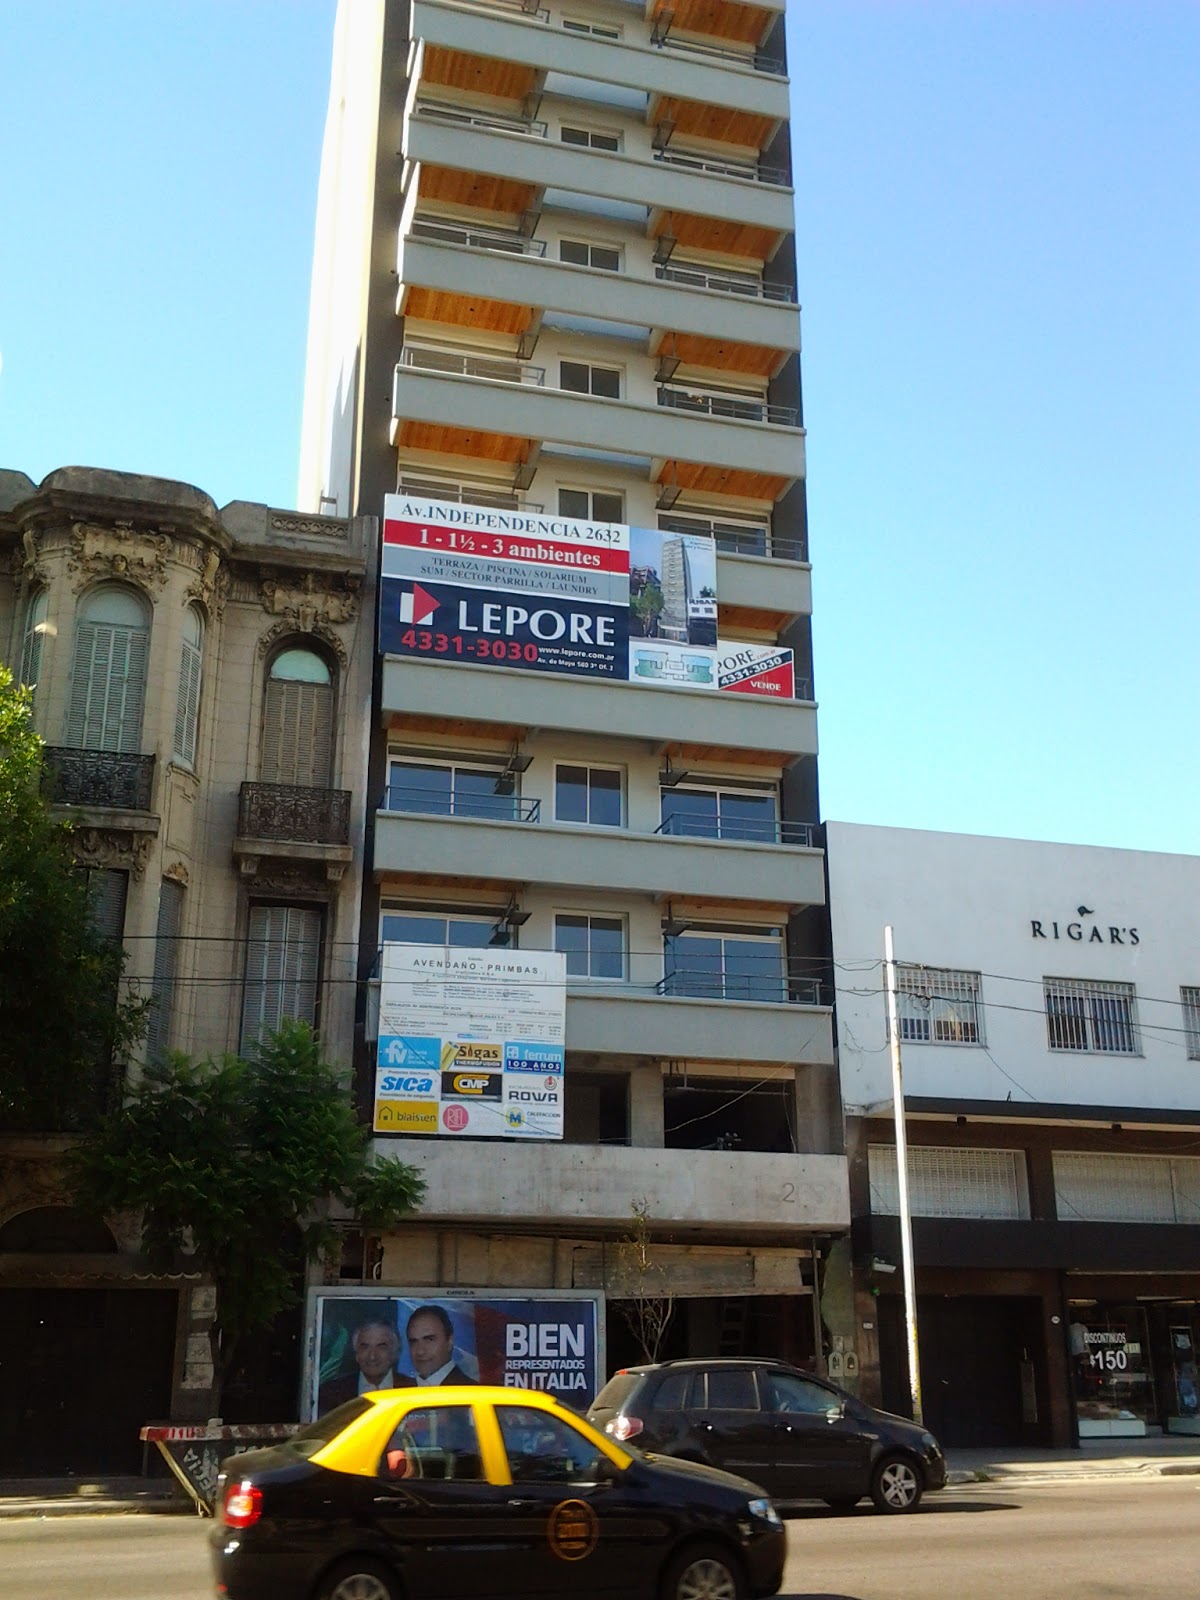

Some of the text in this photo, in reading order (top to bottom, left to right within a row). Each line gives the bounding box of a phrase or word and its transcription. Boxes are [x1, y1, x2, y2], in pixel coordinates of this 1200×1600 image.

[585, 527, 621, 543] 2632
[419, 528, 429, 545] 1
[492, 539, 504, 555] 3
[508, 542, 601, 566] ambientes
[420, 565, 445, 576] SUM
[451, 569, 493, 582] SECTOR
[494, 575, 543, 588] PARRILLA
[551, 581, 599, 595] LAUNDRY
[432, 557, 479, 570] TERRAZA
[486, 564, 526, 576] PISCINA
[534, 569, 587, 584] SOLARIUM
[458, 600, 616, 647] LEPORE
[401, 629, 538, 662] 4331-3030
[538, 647, 615, 661] www.lepore.com.ar
[750, 681, 782, 692] VENDE
[1030, 920, 1140, 945] RIGAR'S
[413, 958, 477, 971] AVENDAÑO
[487, 964, 538, 975] PRIMBAS
[507, 1060, 527, 1068] 100
[508, 1091, 558, 1102] ROWA
[505, 1323, 585, 1358] BIEN
[1084, 1332, 1126, 1344] DISCONTINUOS
[505, 1359, 585, 1370] REPRESENTADOS
[1090, 1350, 1127, 1370] $150
[504, 1371, 587, 1390] EN ITALIA
